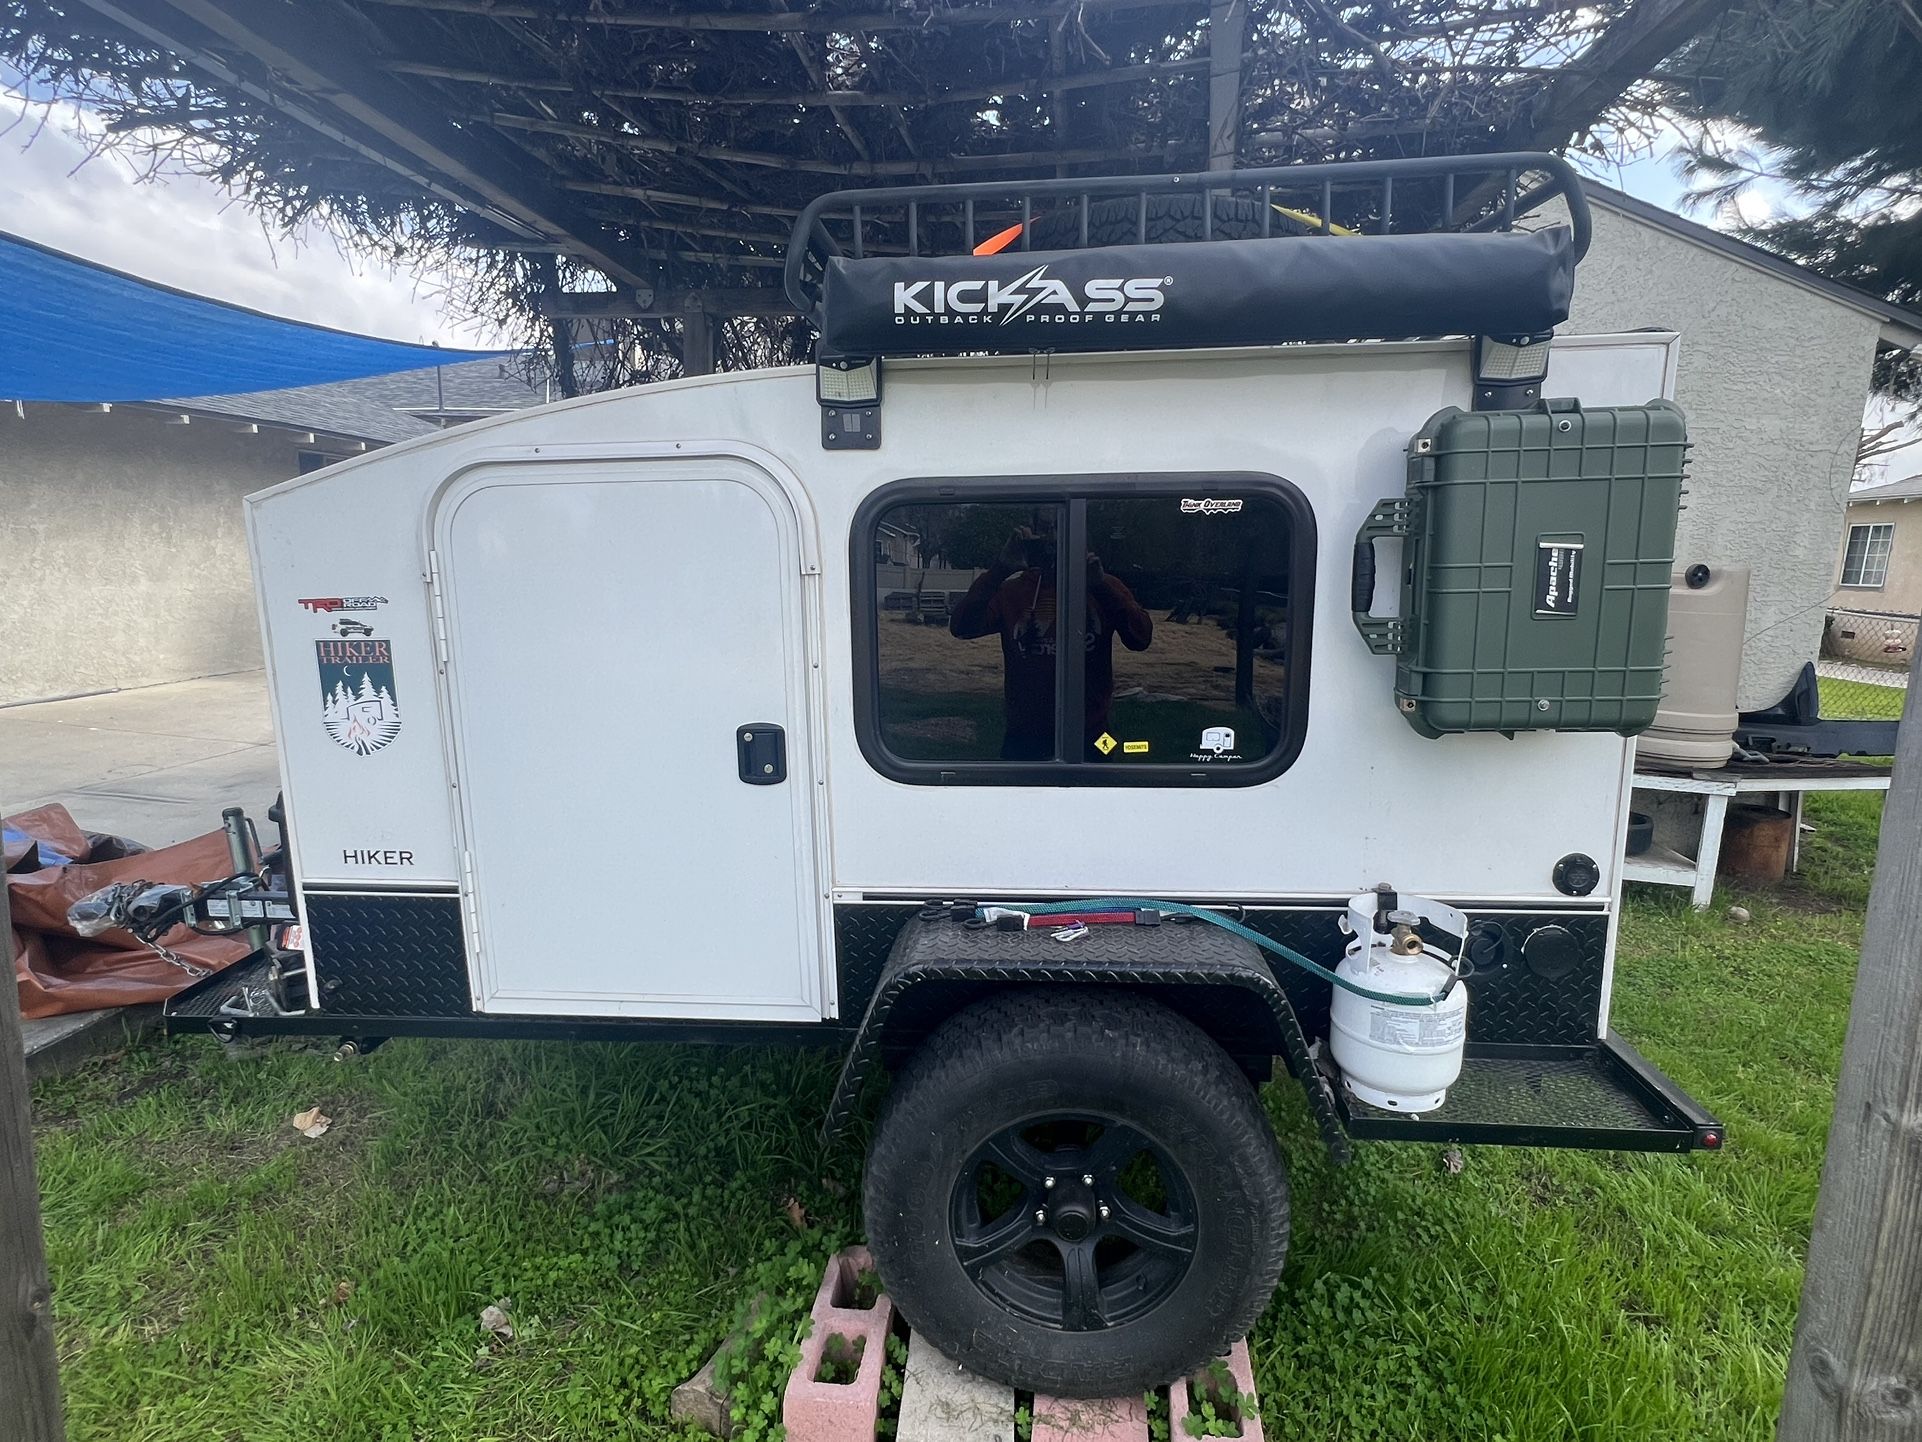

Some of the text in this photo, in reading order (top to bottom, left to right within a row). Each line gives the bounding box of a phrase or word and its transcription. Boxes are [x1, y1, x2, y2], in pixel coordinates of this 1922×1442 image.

[894, 313, 1161, 325] OUTBACK PROOF GEAR
[1545, 548, 1559, 608] Apache
[319, 641, 390, 657] HIKER
[321, 656, 390, 664] TRAILER
[343, 849, 415, 866] HIKER
